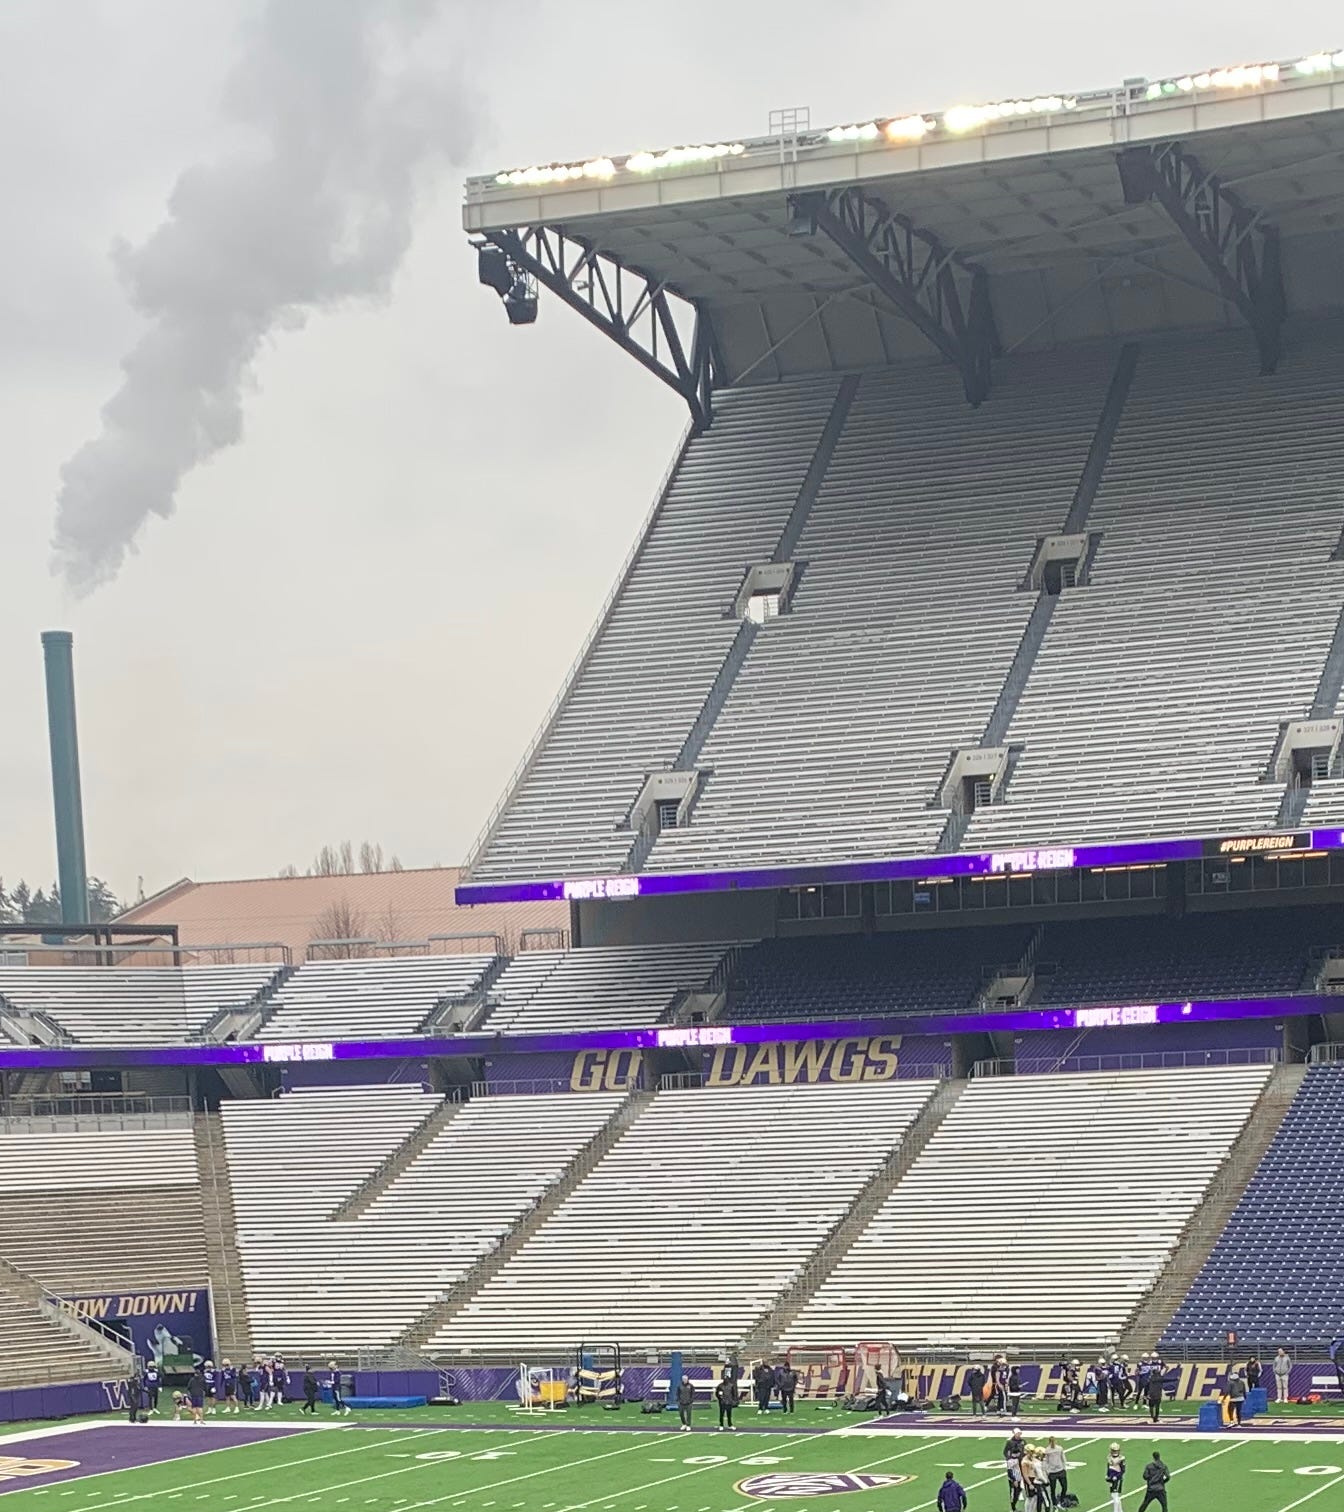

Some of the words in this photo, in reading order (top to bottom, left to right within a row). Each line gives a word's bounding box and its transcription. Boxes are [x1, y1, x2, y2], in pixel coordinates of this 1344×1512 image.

[1220, 836, 1294, 852] #PURPLEREIGN
[992, 851, 1036, 872] PURPLE
[1077, 1009, 1120, 1027] PURPLE
[570, 1049, 643, 1092] GO
[705, 1036, 902, 1087] DAWGS
[117, 1293, 197, 1318] DOWN!
